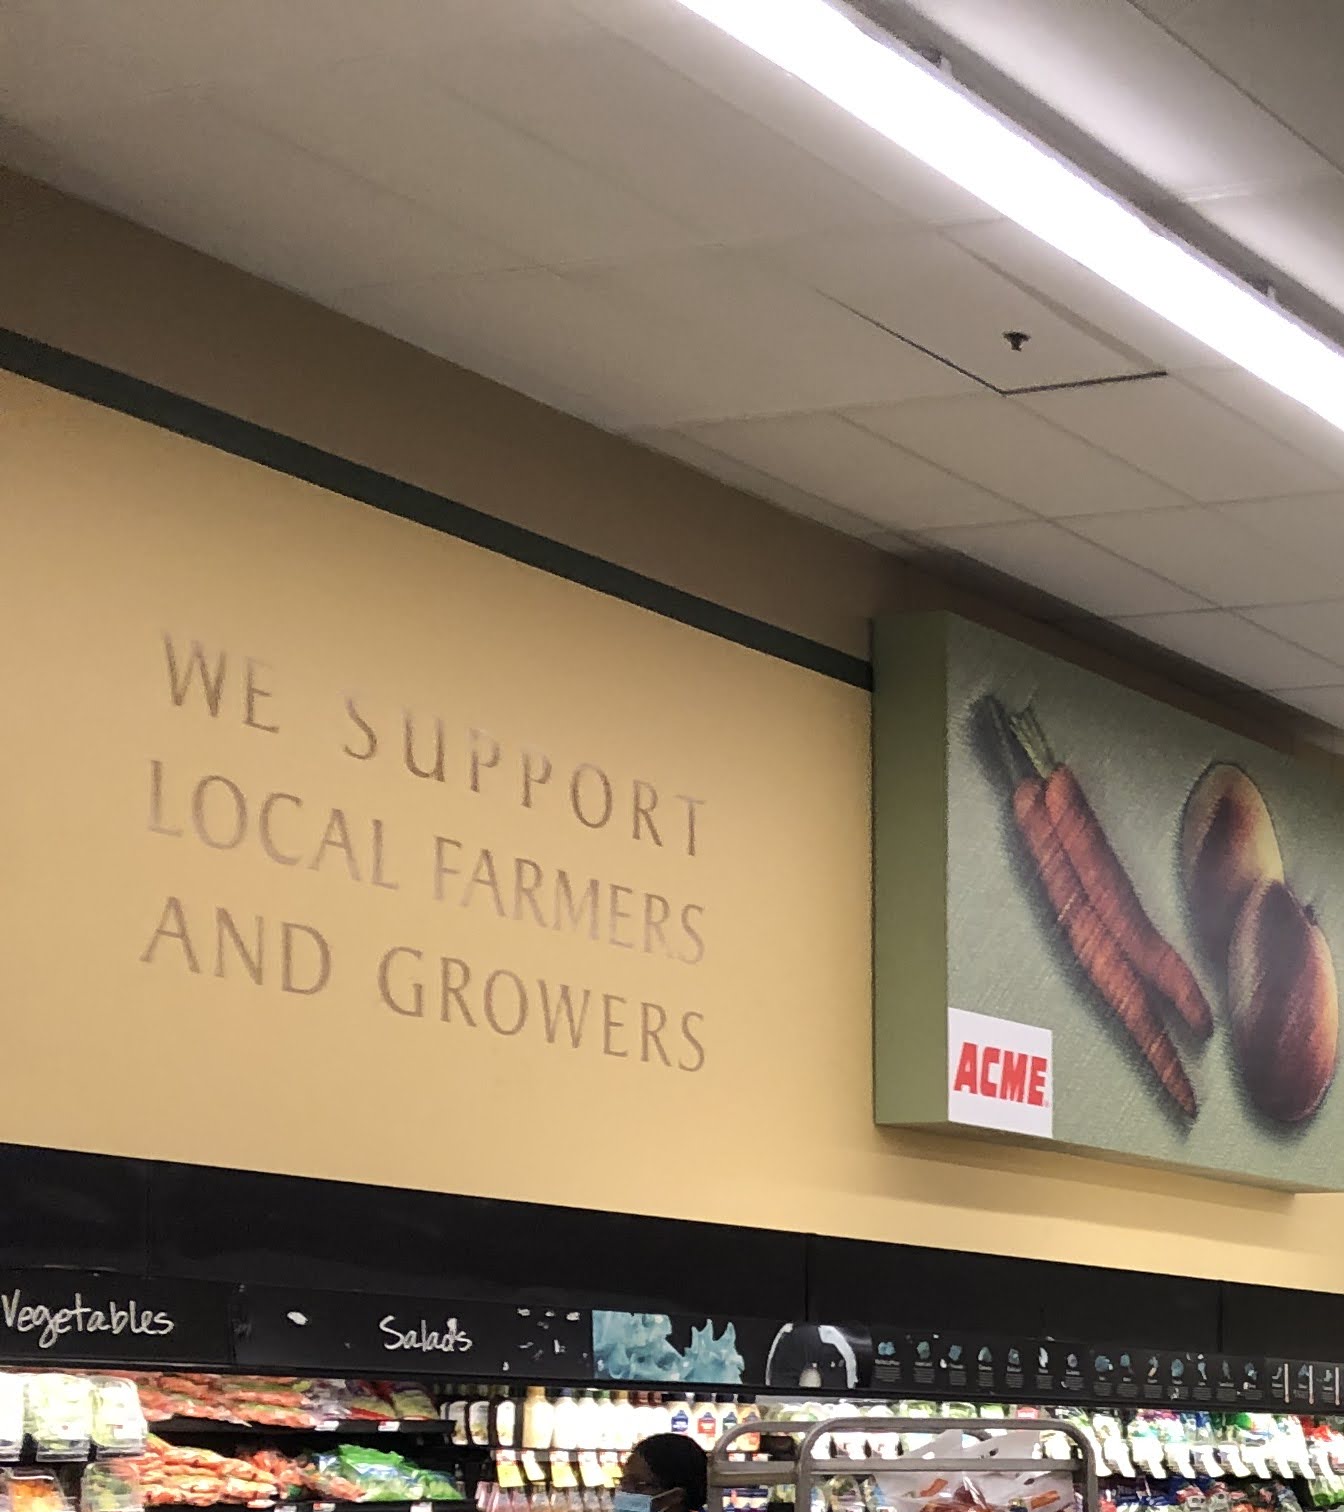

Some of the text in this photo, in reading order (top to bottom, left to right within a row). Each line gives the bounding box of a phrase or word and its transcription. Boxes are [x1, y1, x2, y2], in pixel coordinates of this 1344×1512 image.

[160, 626, 705, 856] WE SUPPORT
[147, 760, 705, 965] LOCAL FARMERS
[139, 896, 705, 1072] AND GROWERS
[954, 1042, 1047, 1107] ACME
[1, 1288, 174, 1348] Vegetables
[379, 1315, 473, 1353] Salads
